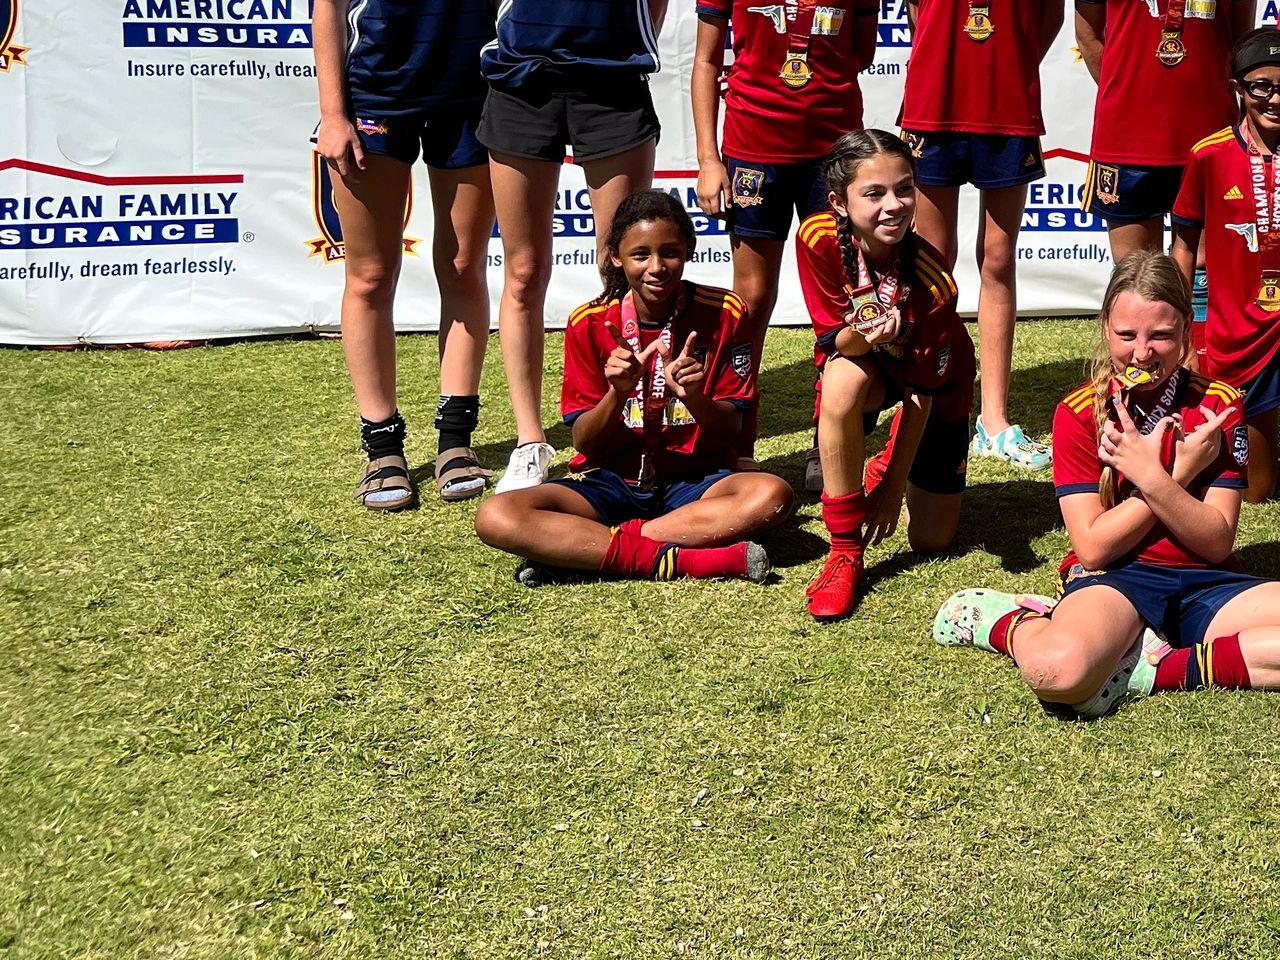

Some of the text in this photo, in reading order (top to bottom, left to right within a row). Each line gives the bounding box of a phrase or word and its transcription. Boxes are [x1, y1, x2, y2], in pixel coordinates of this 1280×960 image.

[147, 27, 309, 44] INSURA
[128, 60, 184, 76] Insure
[190, 60, 270, 79] carefully,
[1250, 155, 1269, 232] CHAMPIONS
[0, 192, 238, 220] RICAN FAMILY
[0, 223, 215, 245] SURANCE
[1038, 244, 1110, 262] carefully,
[0, 256, 236, 281] arefully, dream fearlessly.
